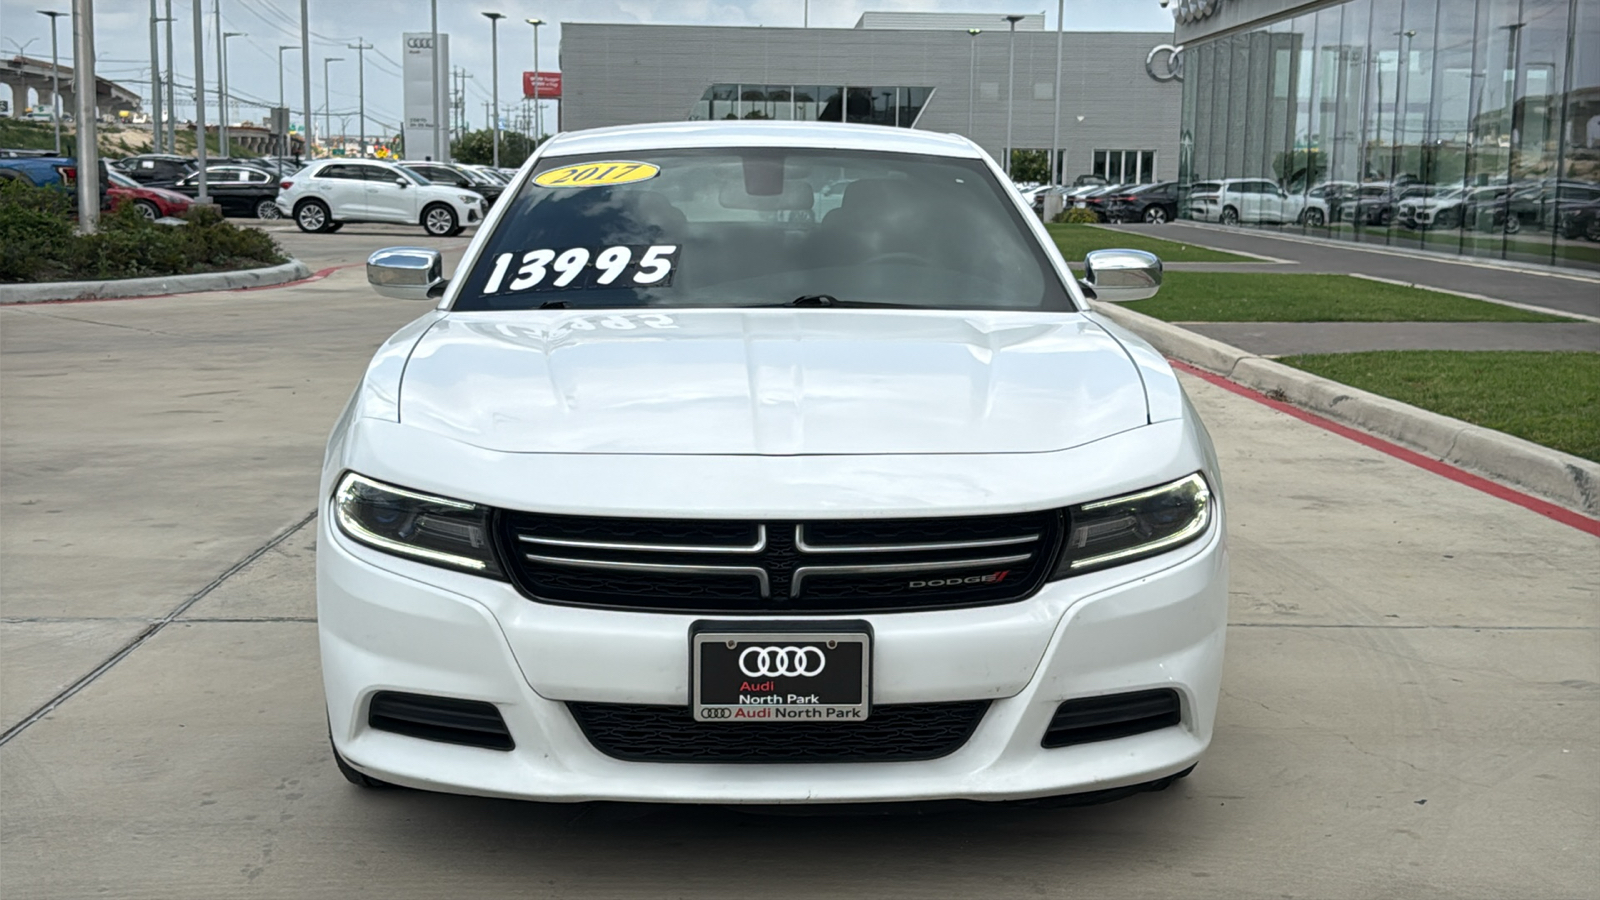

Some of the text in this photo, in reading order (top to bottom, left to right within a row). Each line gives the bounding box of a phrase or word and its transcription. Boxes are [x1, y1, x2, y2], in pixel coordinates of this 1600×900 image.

[550, 164, 644, 184] 2017
[483, 245, 677, 294] 13995
[909, 574, 998, 588] DODGE
[739, 681, 774, 692] Audi
[739, 693, 820, 704] North Park
[734, 707, 861, 718] Audi North Park
